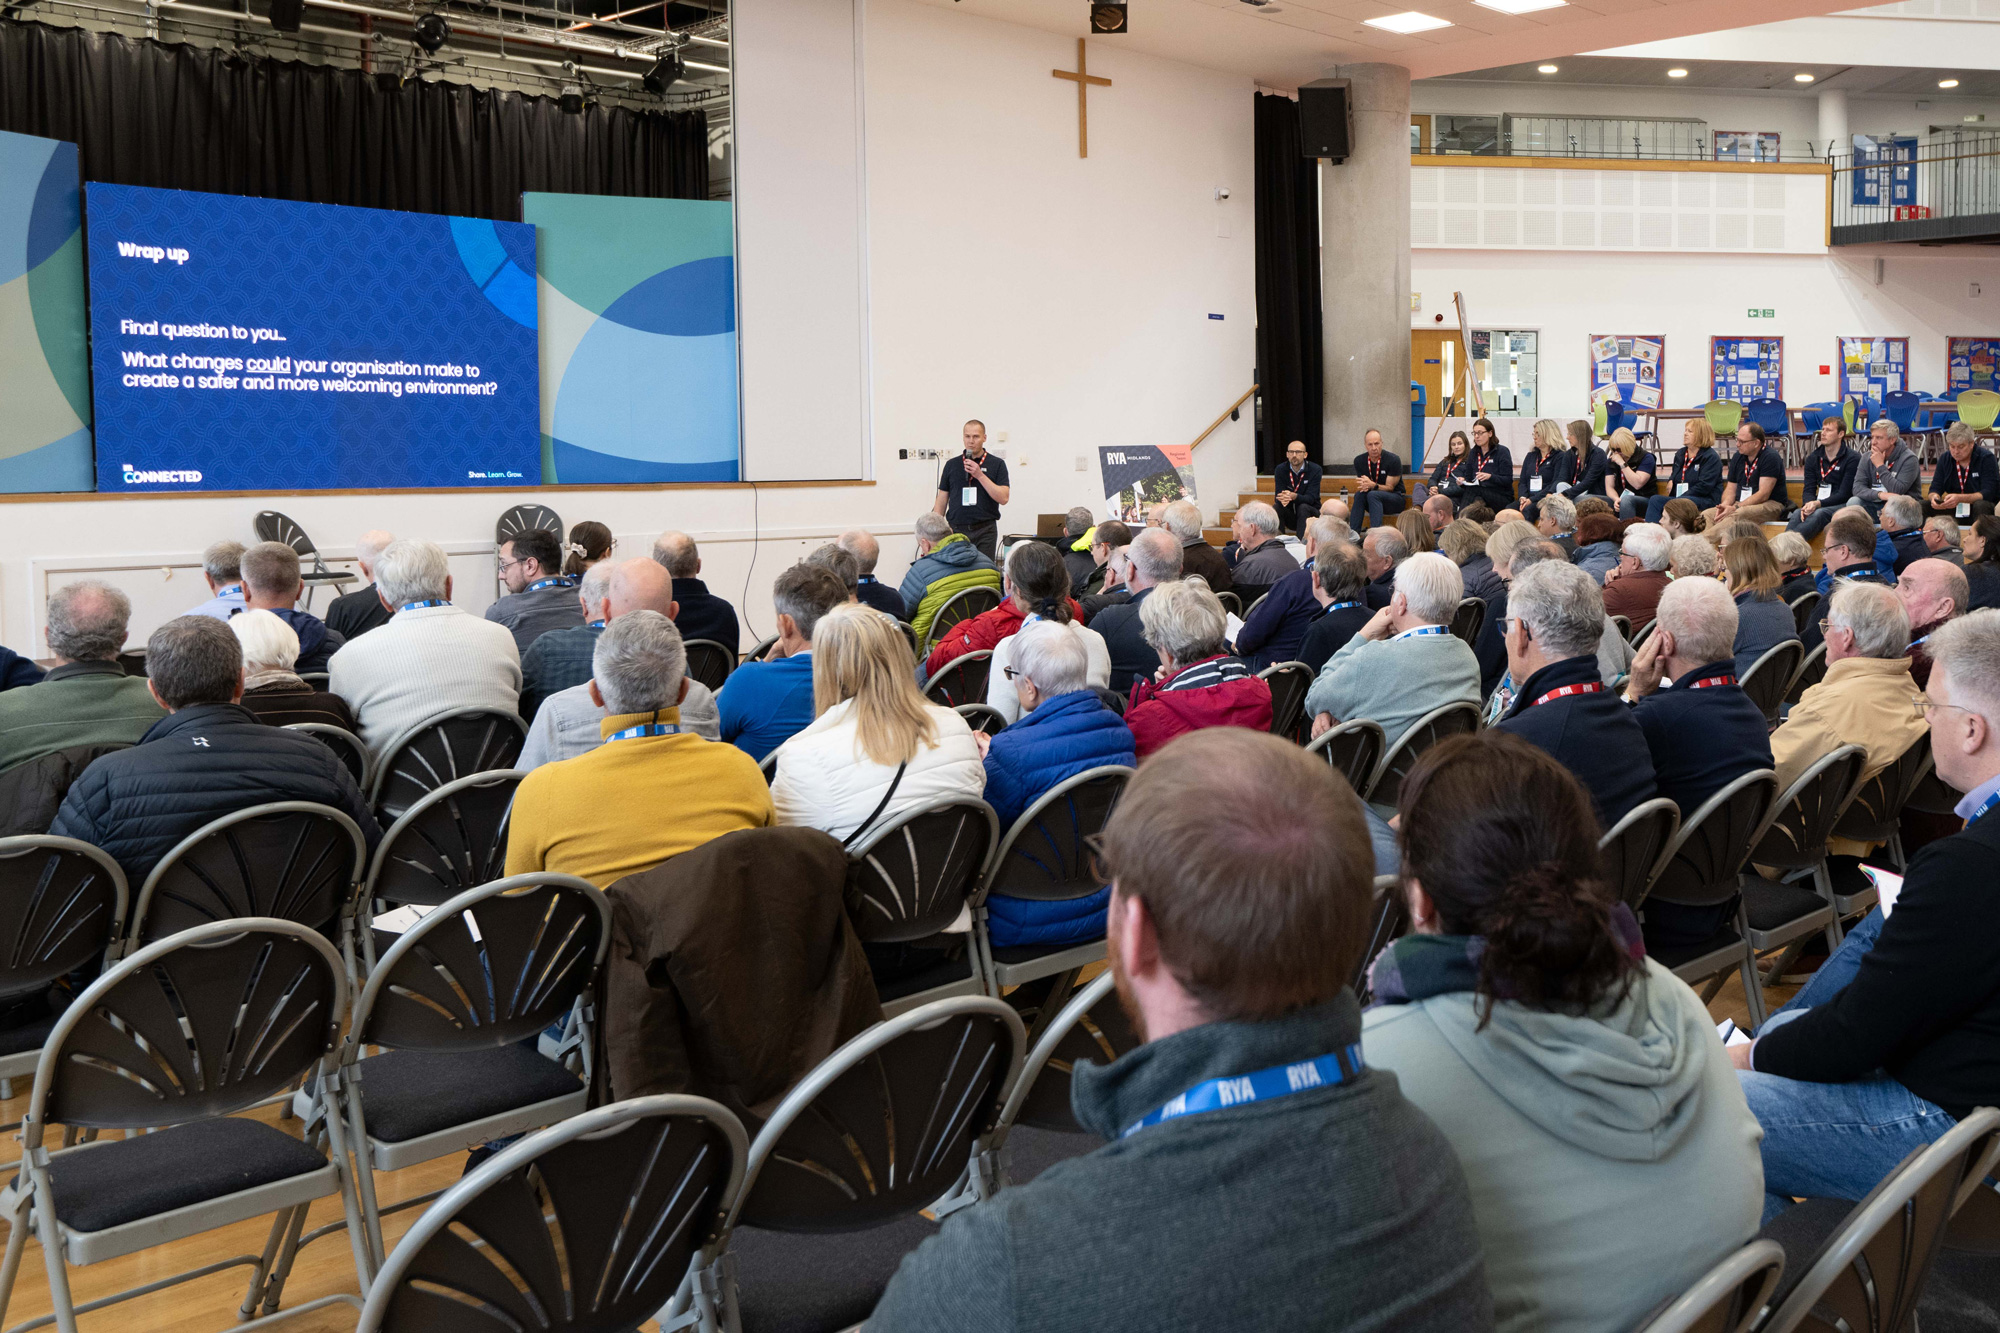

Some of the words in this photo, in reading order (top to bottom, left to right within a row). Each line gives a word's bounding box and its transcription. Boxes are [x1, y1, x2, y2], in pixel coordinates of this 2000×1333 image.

[118, 242, 165, 263] Wrap
[167, 248, 189, 265] up
[121, 319, 158, 335] Final
[161, 323, 229, 340] question
[231, 325, 248, 339] to
[122, 351, 168, 368] What
[171, 353, 243, 374] changes
[246, 356, 291, 374] could
[294, 359, 328, 376] your
[331, 360, 421, 377] organisation
[424, 362, 463, 377] make
[465, 364, 480, 377] to
[123, 373, 179, 388] create
[182, 375, 194, 388] a
[198, 374, 240, 389] safer
[242, 375, 274, 390] and
[278, 377, 319, 391] more
[322, 377, 402, 397] welcoming
[405, 379, 497, 395] environment?
[1107, 452, 1127, 466] RYA
[123, 470, 203, 484] CONNECTED
[468, 470, 487, 478] Share.
[506, 470, 523, 478] Grow.
[1538, 694, 1549, 705] RYA
[1559, 686, 1573, 696] RYA
[1582, 684, 1594, 693] RYA
[1216, 1076, 1256, 1108] RYA
[1286, 1061, 1322, 1092] RYA
